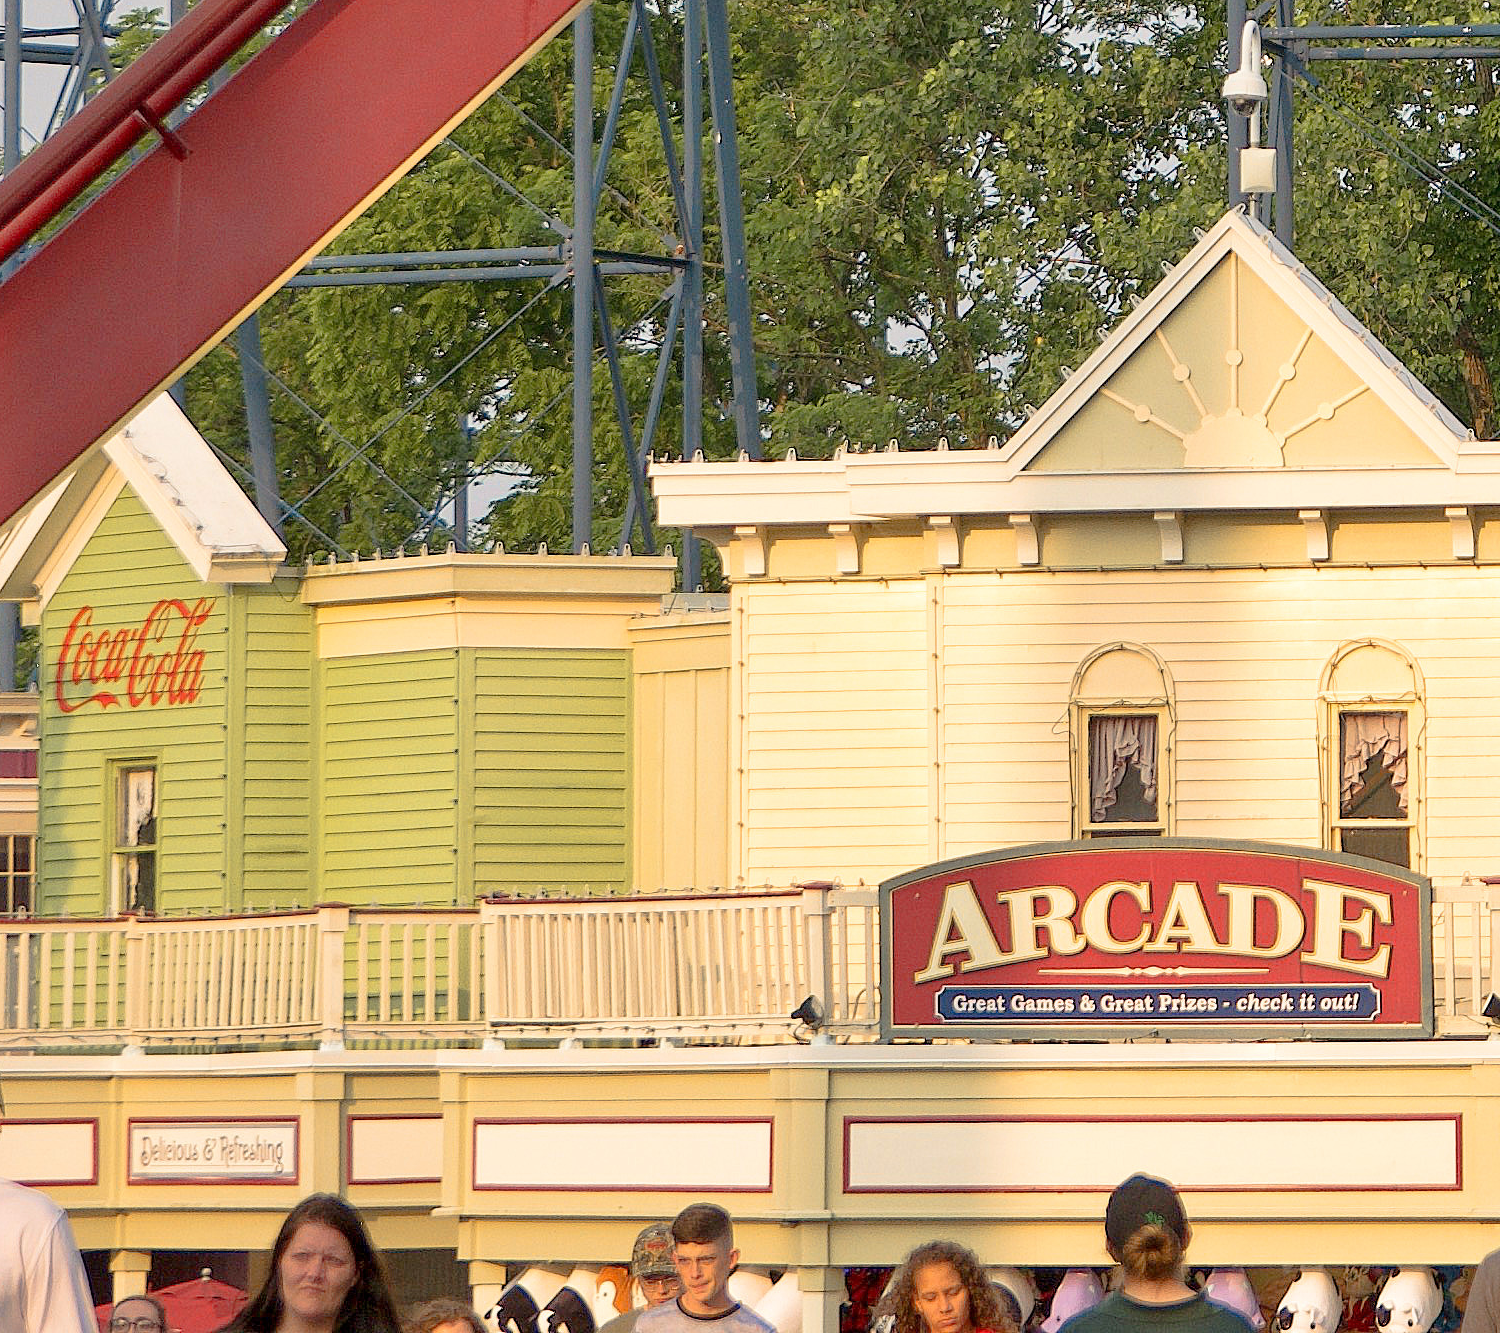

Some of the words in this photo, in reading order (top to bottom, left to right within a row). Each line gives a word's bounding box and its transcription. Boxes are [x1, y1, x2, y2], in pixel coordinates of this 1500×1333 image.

[914, 878, 1393, 984] ARCADE
[953, 994, 1005, 1012] Great
[1011, 994, 1074, 1012] Games
[1080, 995, 1095, 1012] &
[1101, 994, 1155, 1012] Great
[1160, 993, 1217, 1012] Prizes
[1236, 993, 1294, 1011] check
[1300, 993, 1316, 1011] it
[1320, 993, 1360, 1011] out!
[141, 1136, 198, 1166] Delicious
[203, 1138, 217, 1161] &
[220, 1135, 284, 1173] Refreshing
